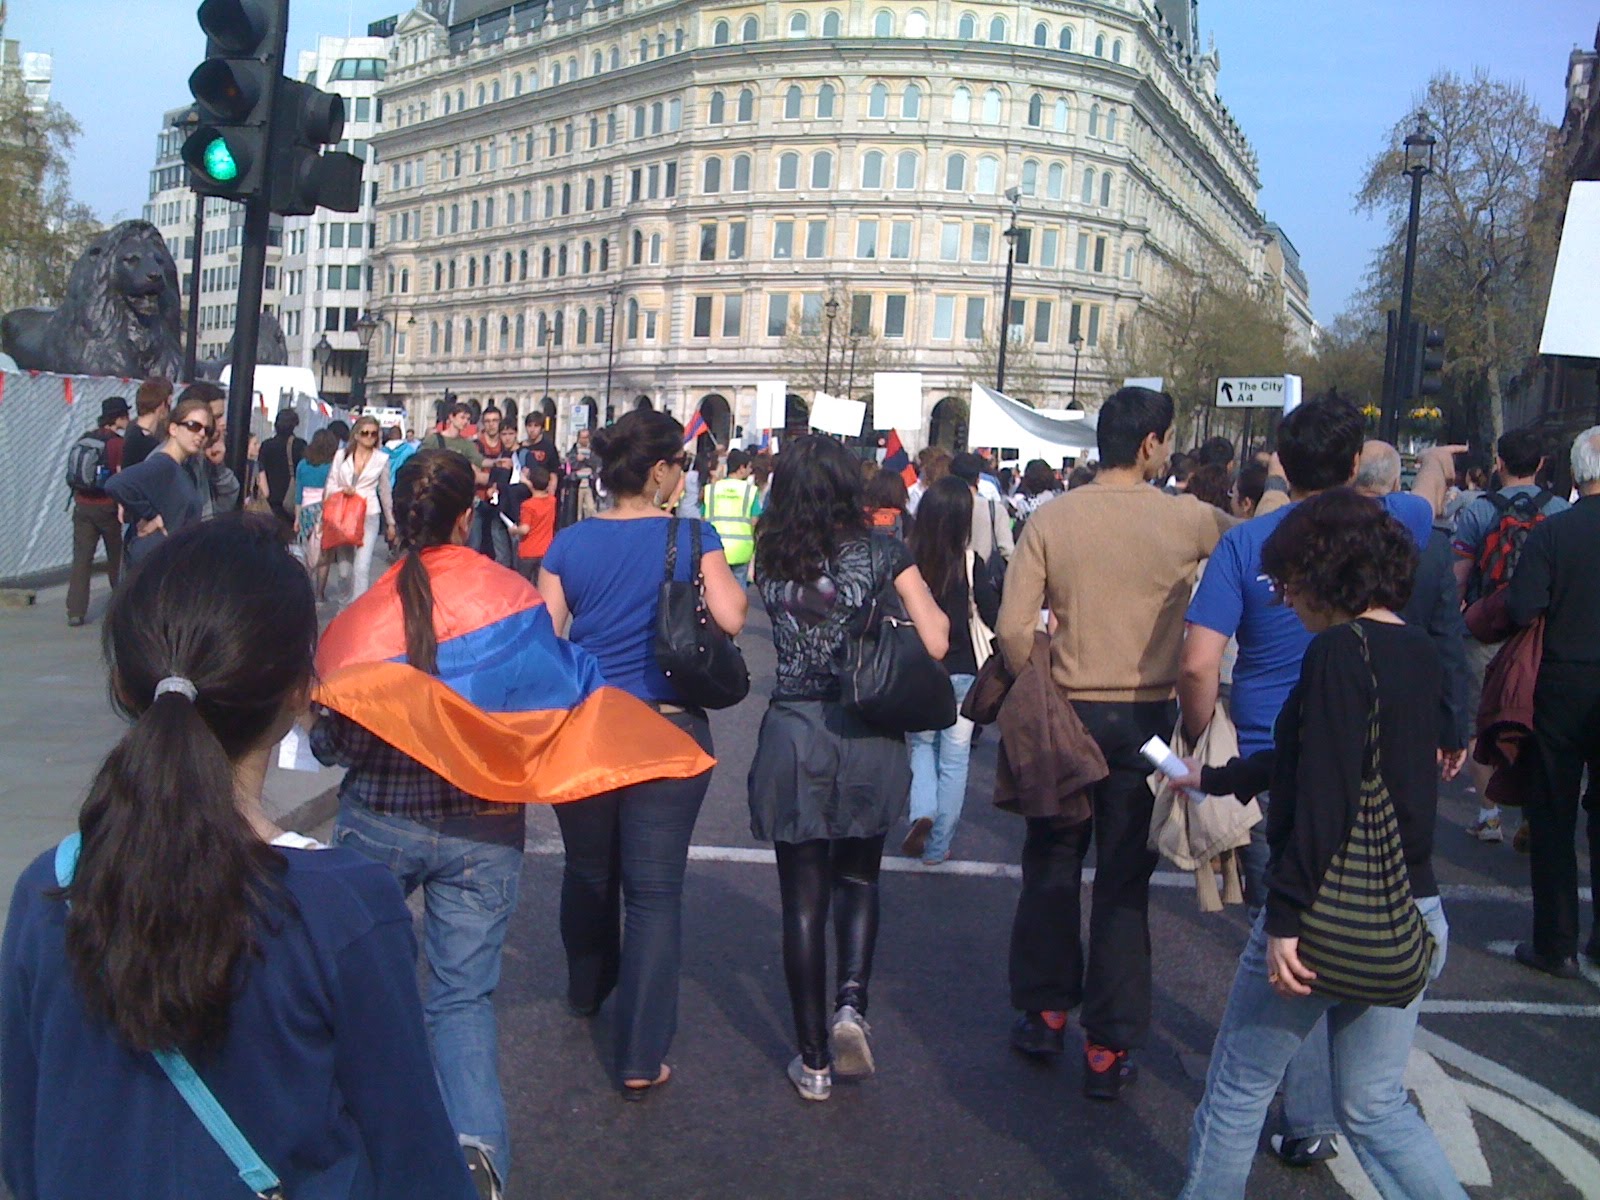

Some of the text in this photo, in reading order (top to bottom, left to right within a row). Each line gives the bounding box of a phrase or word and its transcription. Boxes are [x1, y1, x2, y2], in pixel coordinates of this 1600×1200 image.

[1238, 382, 1283, 392] The City
[1237, 393, 1253, 402] A4
